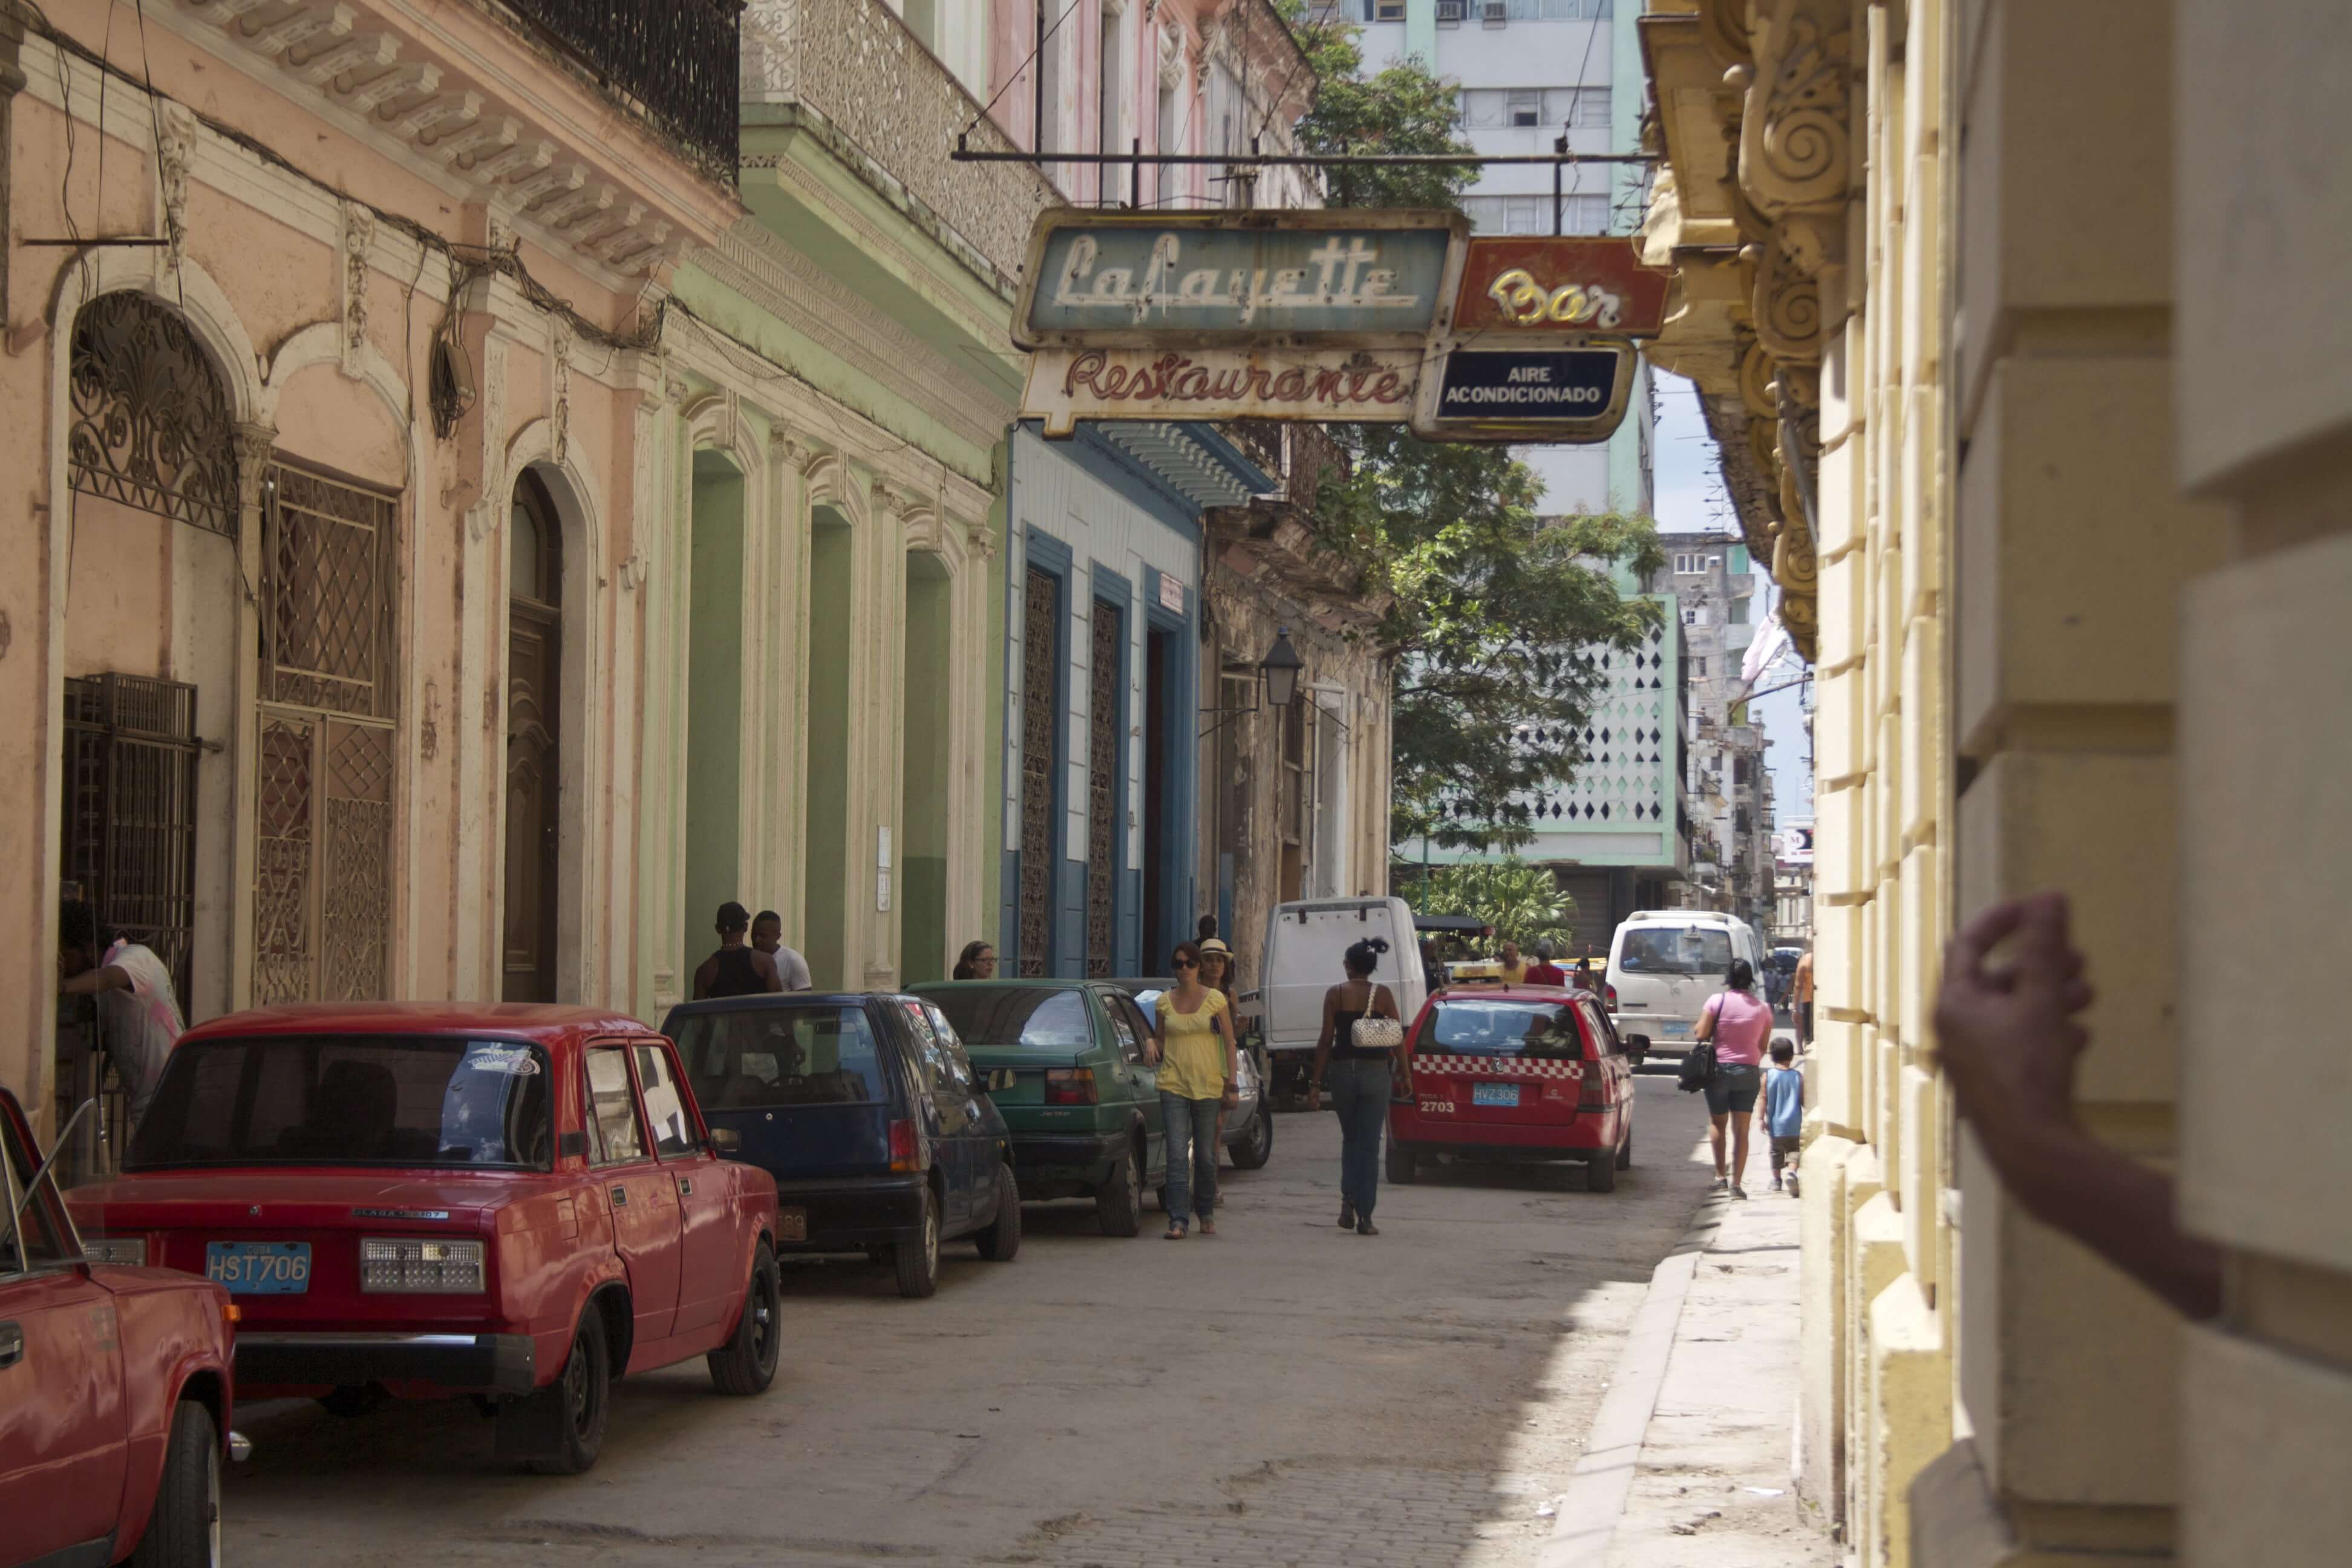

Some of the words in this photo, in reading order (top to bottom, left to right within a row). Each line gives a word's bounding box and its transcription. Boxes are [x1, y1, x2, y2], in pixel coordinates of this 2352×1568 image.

[1054, 234, 1418, 325] Lafayette
[1487, 268, 1621, 330] Bar
[1065, 351, 1410, 404] Restaurante
[1507, 367, 1552, 382] AIRE
[1445, 386, 1601, 403] ACONDICIONADO
[1474, 1088, 1518, 1100] HVZ306
[1420, 1101, 1455, 1113] 2703
[246, 1244, 272, 1255] CUBA
[208, 1255, 307, 1281] HST706
